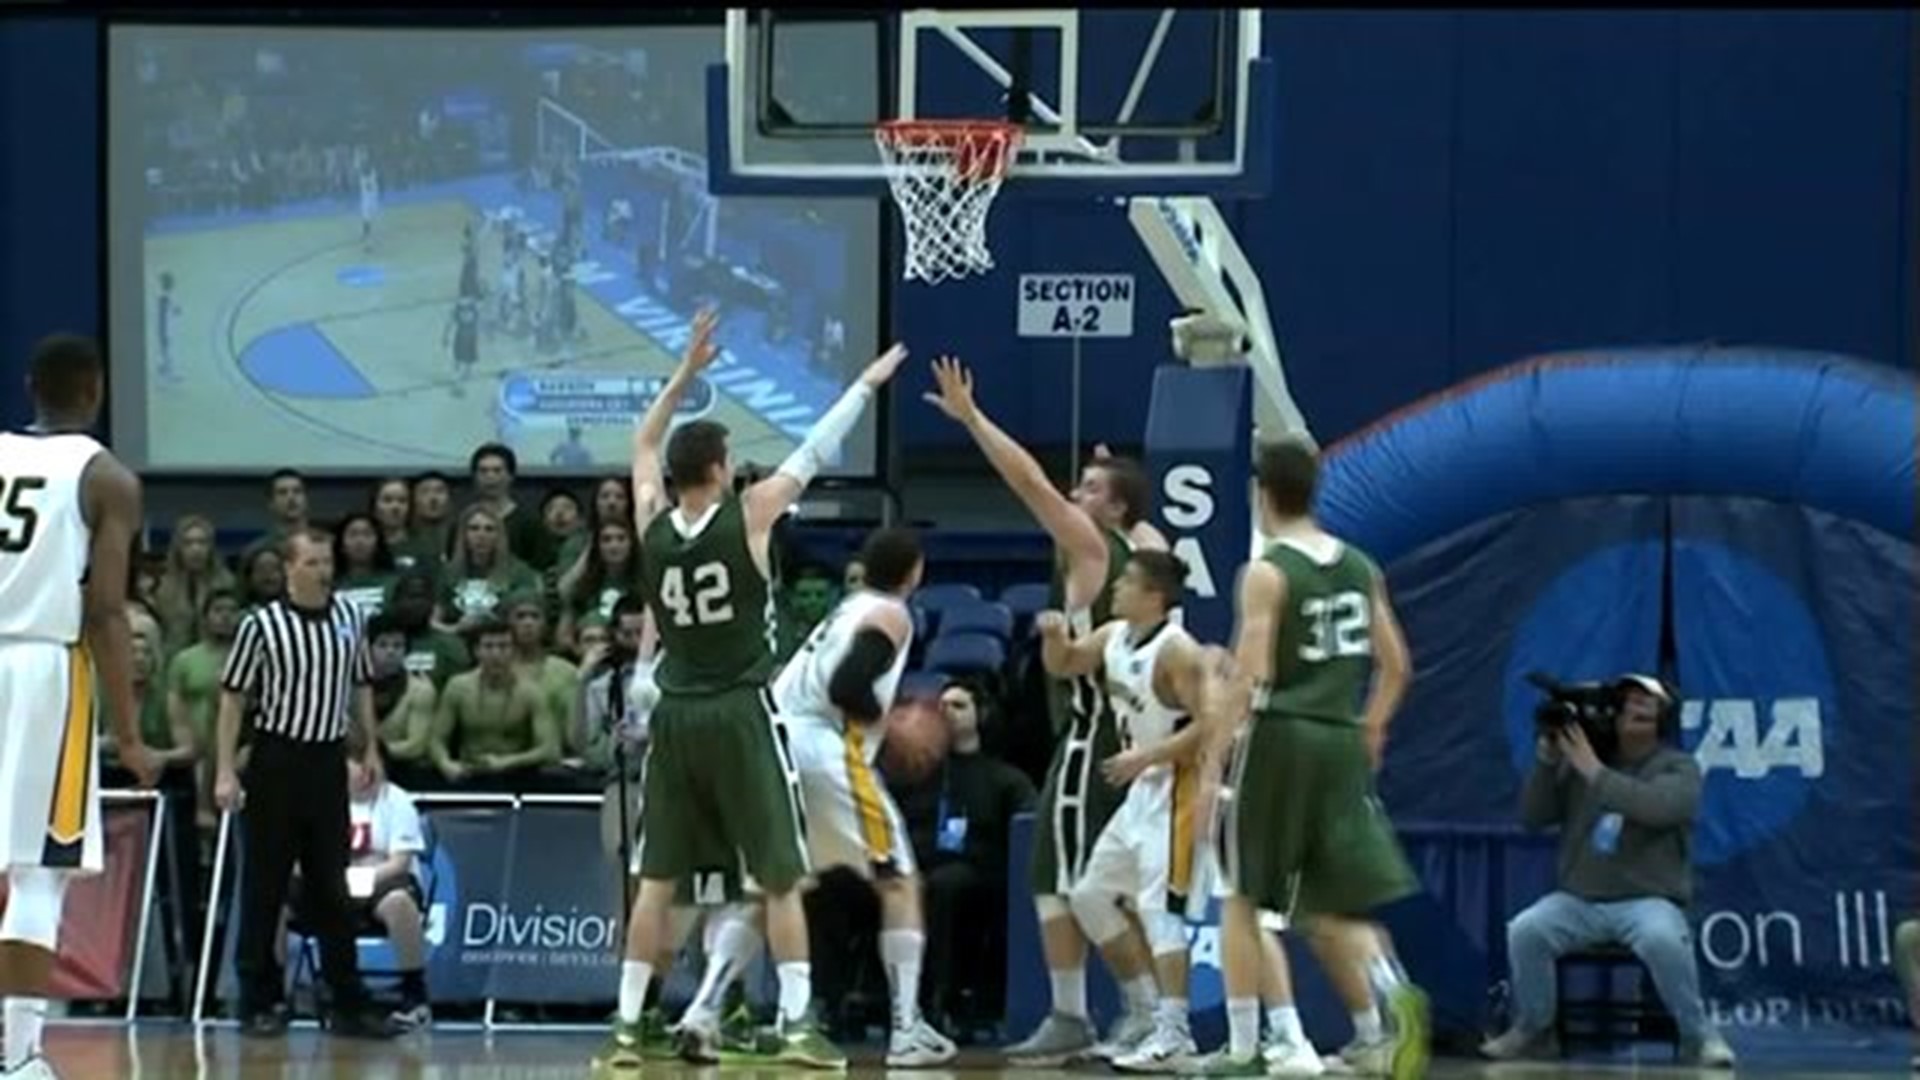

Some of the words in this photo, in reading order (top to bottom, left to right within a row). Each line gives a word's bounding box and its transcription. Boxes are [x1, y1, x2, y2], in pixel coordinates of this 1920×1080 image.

[1023, 279, 1131, 302] SECTION
[1052, 305, 1100, 332] A-2
[0, 476, 47, 554] 5
[1162, 464, 1217, 622] SA
[660, 561, 734, 626] 42
[1298, 591, 1371, 661] 32
[1680, 697, 1824, 780] AA
